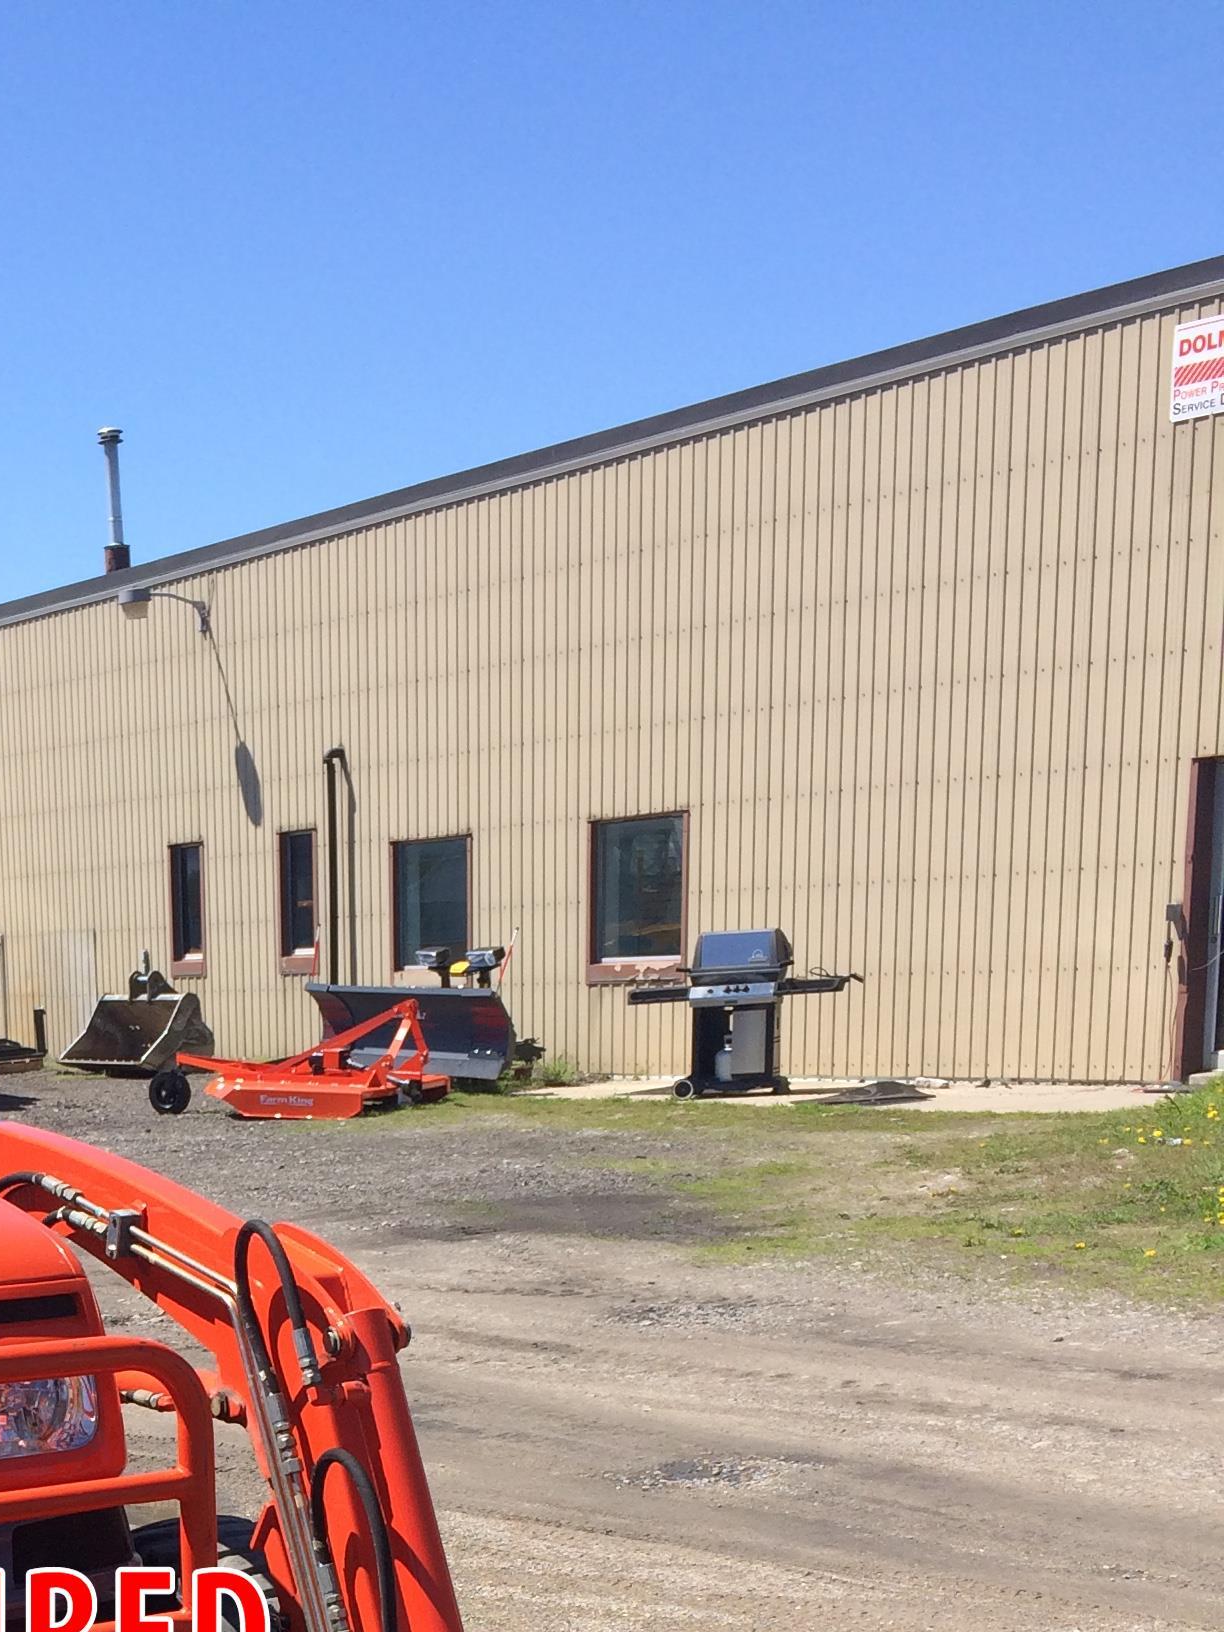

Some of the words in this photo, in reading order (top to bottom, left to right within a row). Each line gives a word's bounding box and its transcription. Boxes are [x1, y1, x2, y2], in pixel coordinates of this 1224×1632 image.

[1174, 387, 1207, 401] POWER
[1173, 399, 1216, 415] SERVICE
[260, 1094, 288, 1105] Farm
[289, 1095, 314, 1106] King
